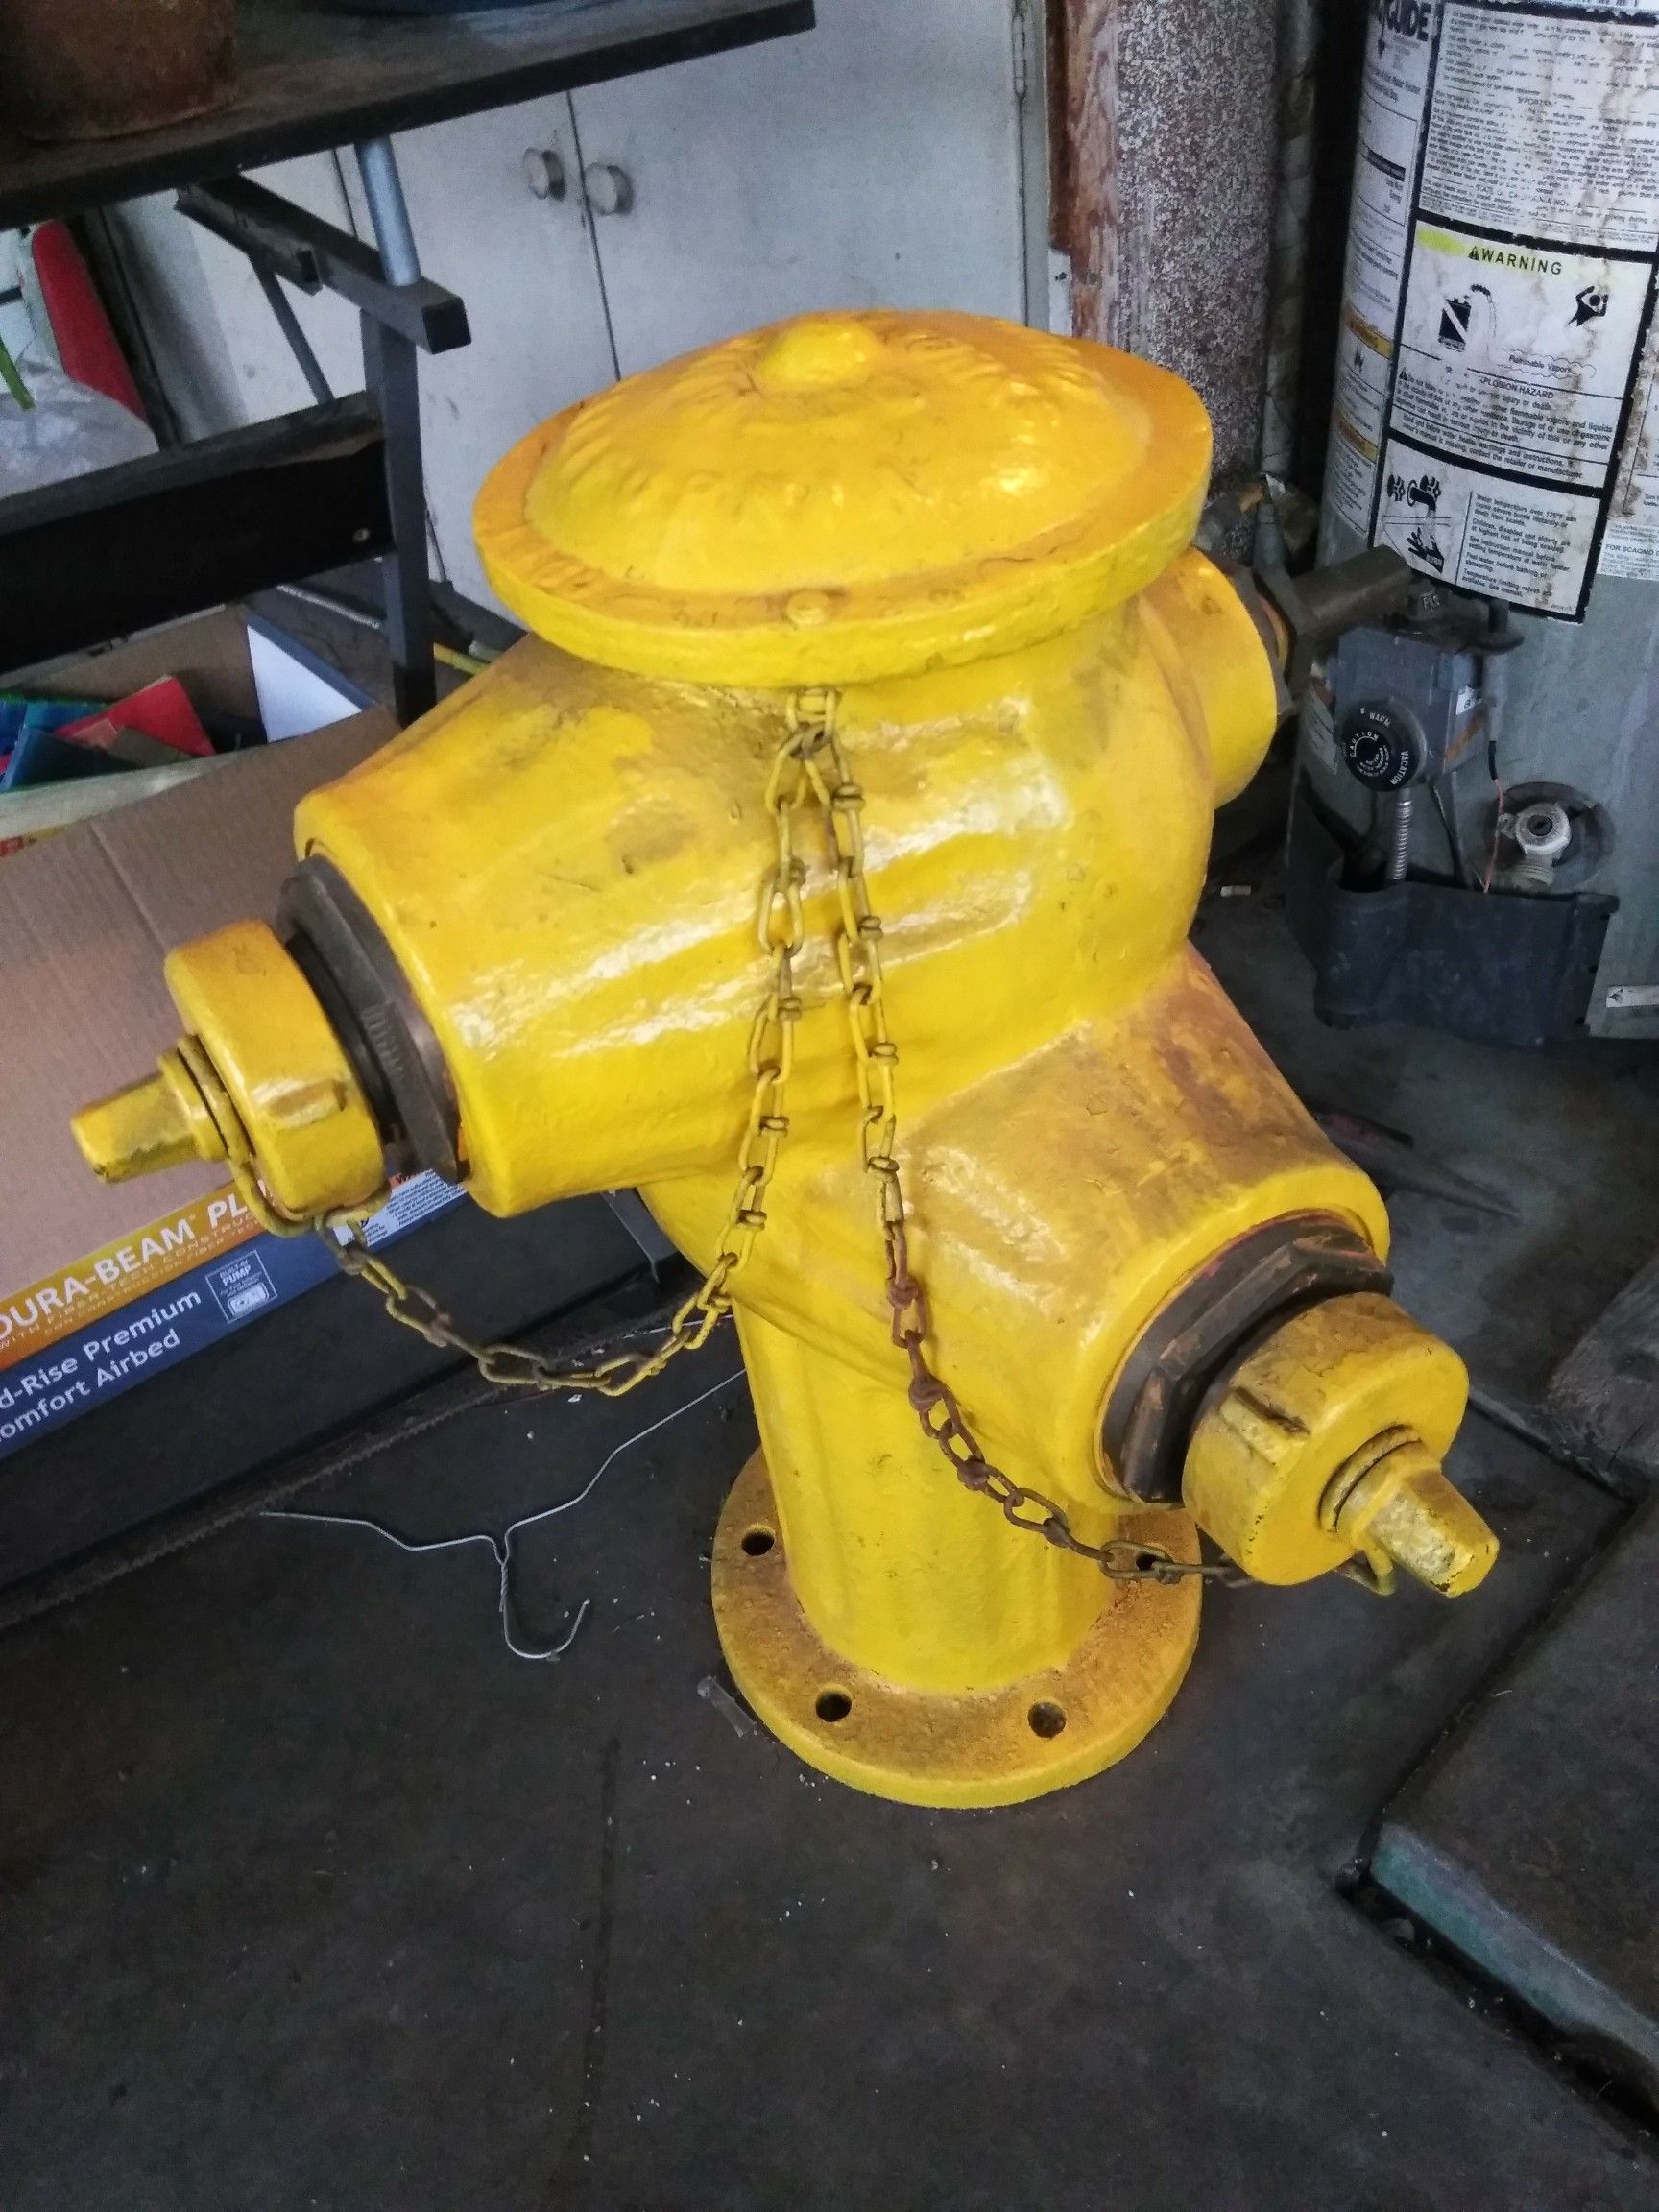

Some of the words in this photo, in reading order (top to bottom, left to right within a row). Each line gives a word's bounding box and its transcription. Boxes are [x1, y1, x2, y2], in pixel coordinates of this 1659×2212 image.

[1481, 247, 1563, 276] WARNING
[1519, 384, 1554, 399] HAZARD
[1588, 422, 1613, 433] liquids
[1589, 442, 1609, 450] other
[1369, 711, 1391, 727] WARM
[1349, 731, 1379, 757] CAUTION
[1389, 750, 1409, 785] VACATION
[222, 1264, 251, 1287] PUMP
[83, 1291, 202, 1362] Premium
[97, 1328, 180, 1388] Airbed
